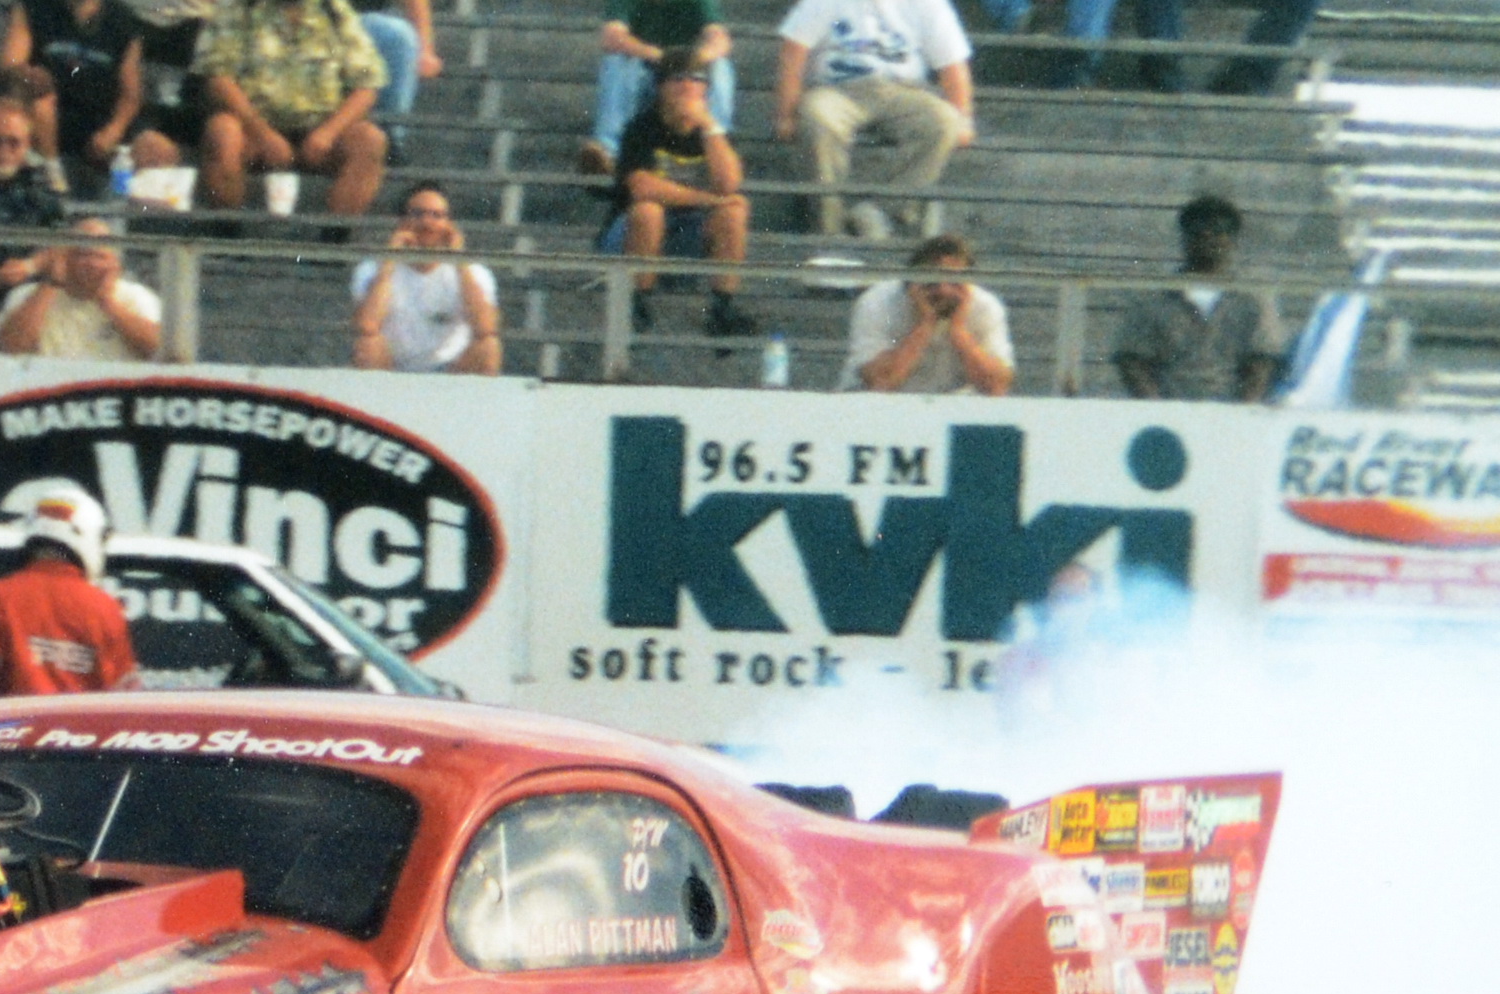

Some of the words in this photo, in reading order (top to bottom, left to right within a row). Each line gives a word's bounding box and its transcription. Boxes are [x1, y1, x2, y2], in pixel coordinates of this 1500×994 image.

[2, 397, 122, 439] MAKE
[132, 396, 434, 484] HORSEPOWER
[698, 440, 813, 485] 96.5
[845, 444, 930, 486] FM
[568, 639, 684, 683] soft
[713, 644, 845, 688] rock
[941, 649, 1000, 693] le
[36, 729, 97, 749] Pro
[100, 730, 199, 752] MOD
[199, 728, 424, 767] ShootOut
[623, 851, 649, 891] 10
[589, 917, 678, 955] PITTMAN
